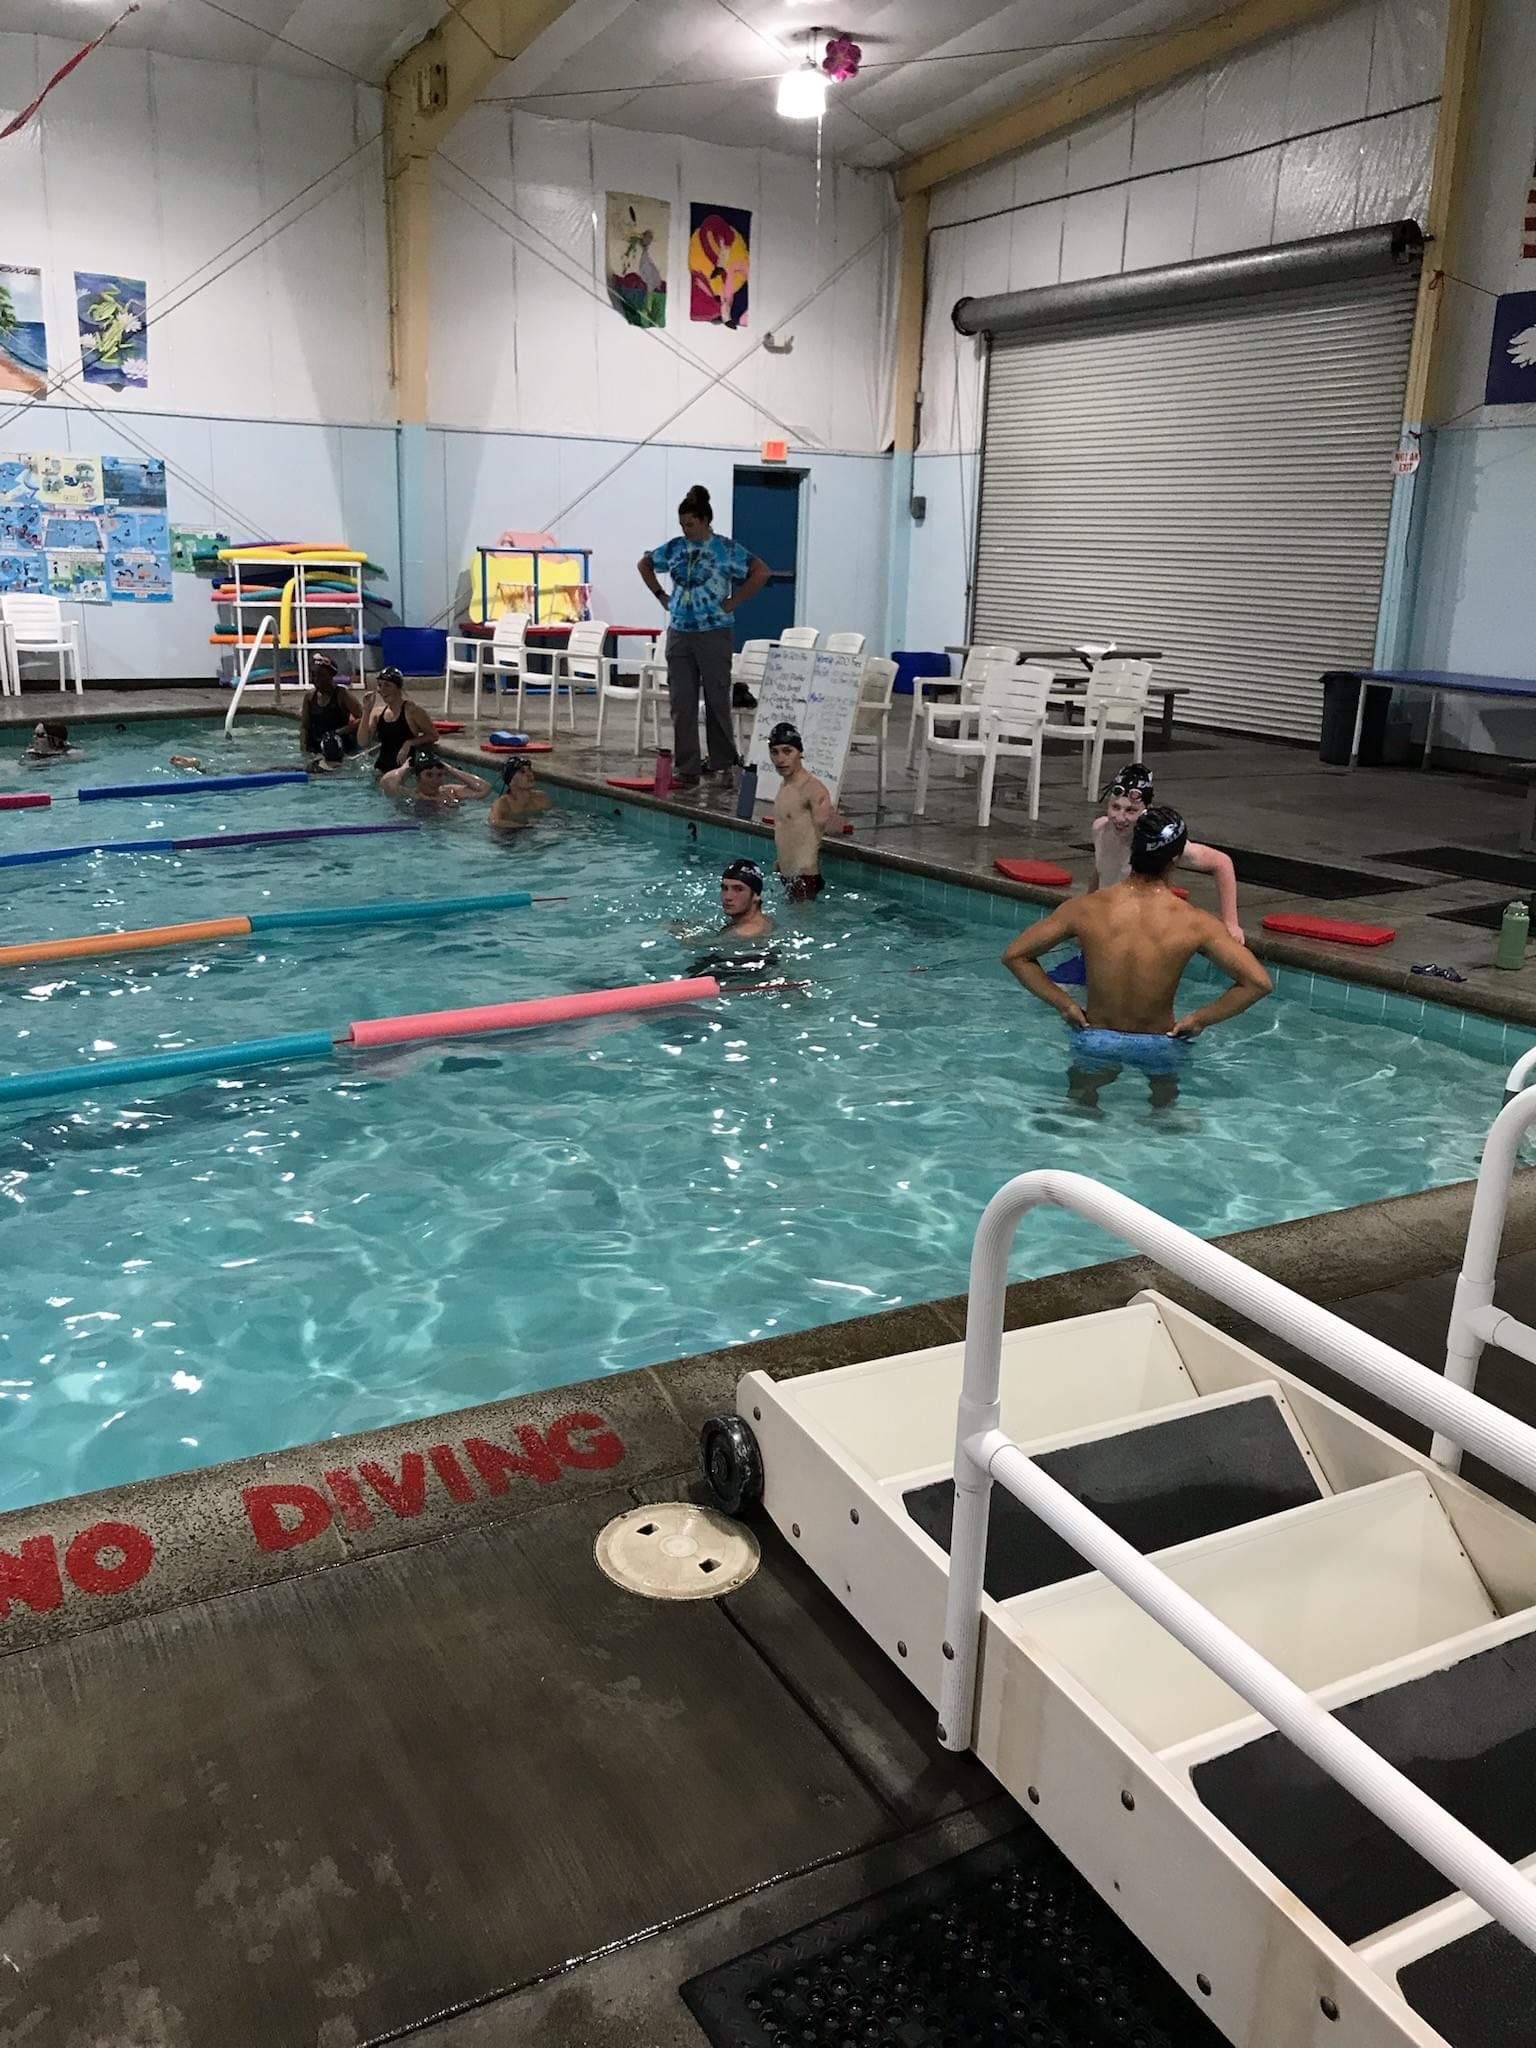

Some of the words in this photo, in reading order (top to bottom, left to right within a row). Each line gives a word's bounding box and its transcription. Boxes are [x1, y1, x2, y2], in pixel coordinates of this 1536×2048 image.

[1399, 463, 1412, 472] EXIT
[0, 1521, 154, 1621] NO
[242, 1412, 626, 1553] DIVING
